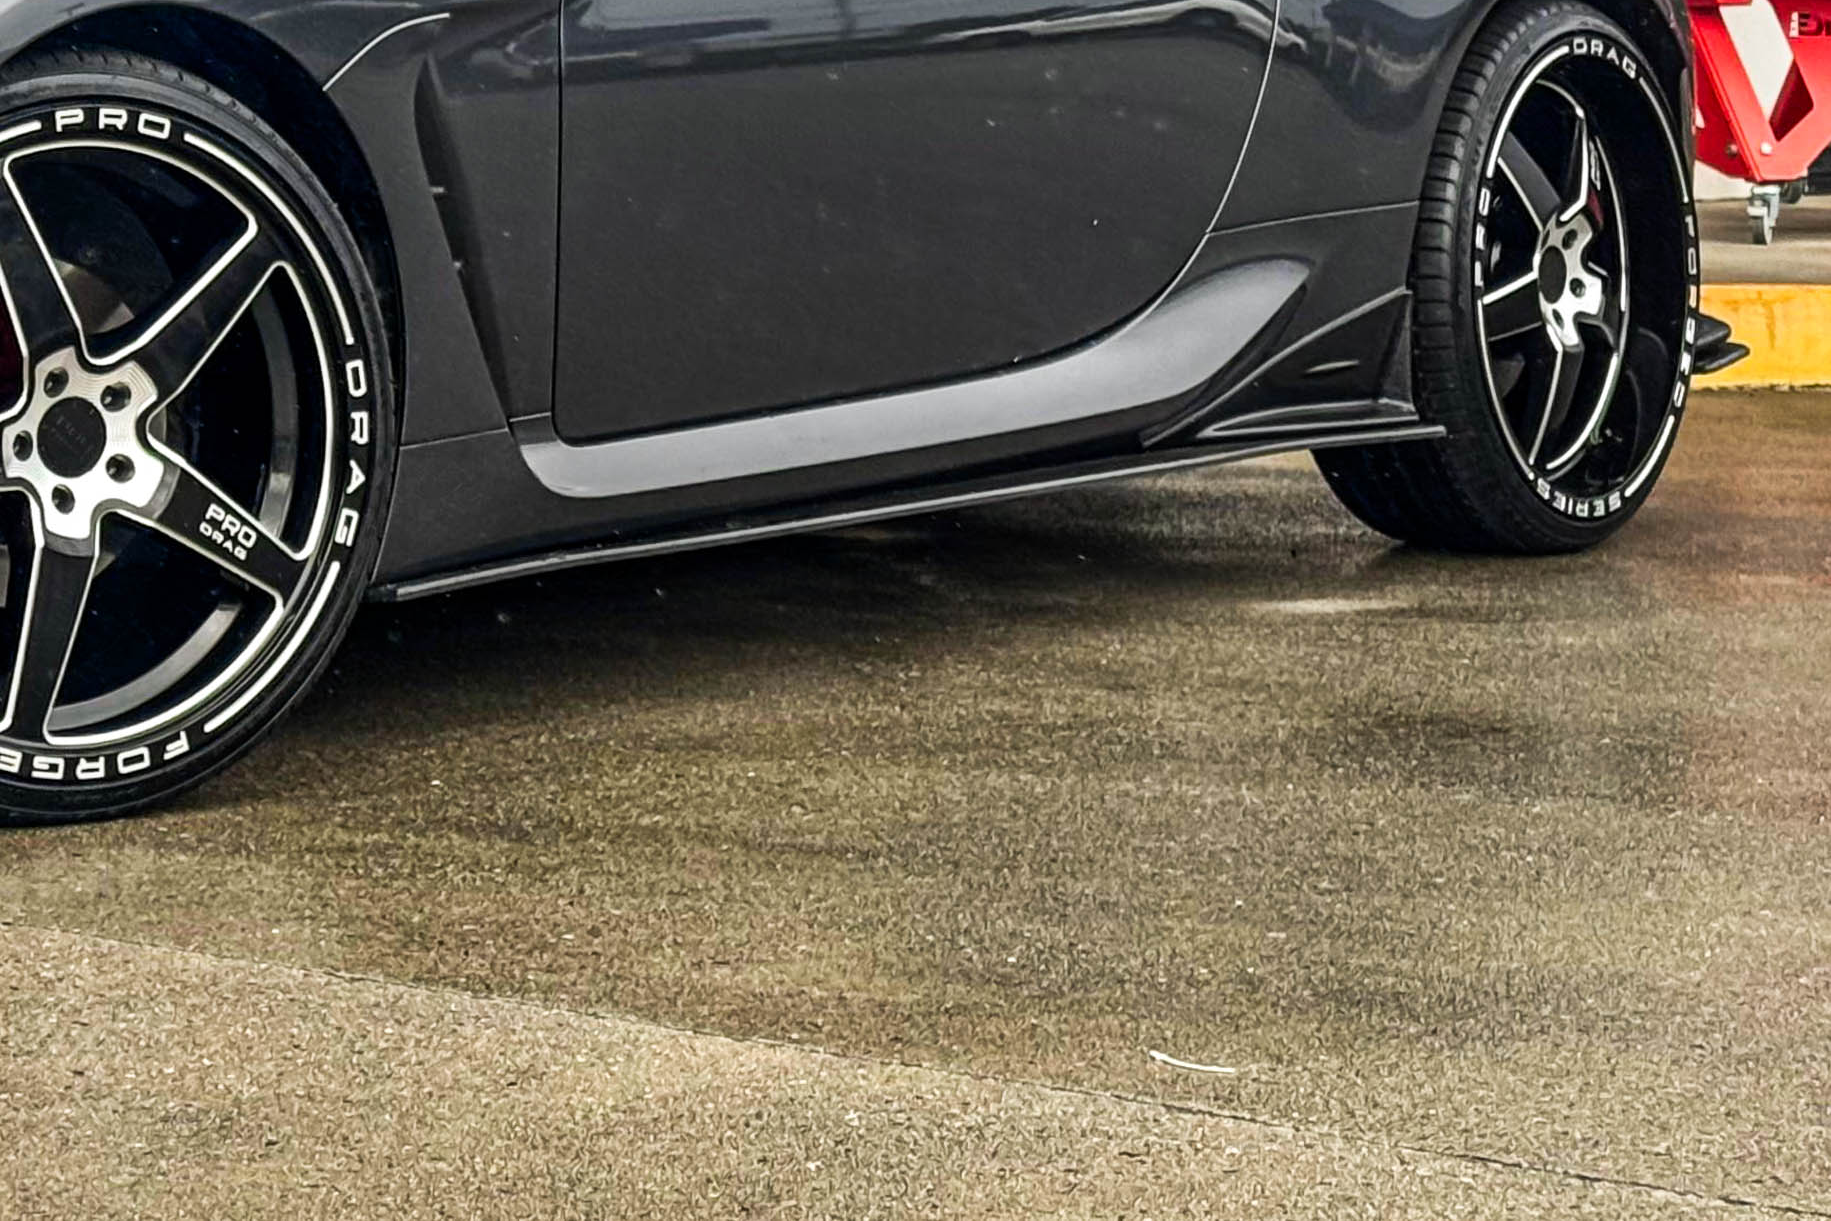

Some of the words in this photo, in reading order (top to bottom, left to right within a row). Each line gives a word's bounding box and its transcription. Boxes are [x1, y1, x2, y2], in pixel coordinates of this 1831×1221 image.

[1573, 37, 1636, 79] DRAG
[54, 108, 172, 140] PRO
[334, 359, 369, 547] DRAG
[1537, 478, 1621, 517] SERIES
[199, 521, 248, 561] DRAG
[205, 503, 257, 549] PRO
